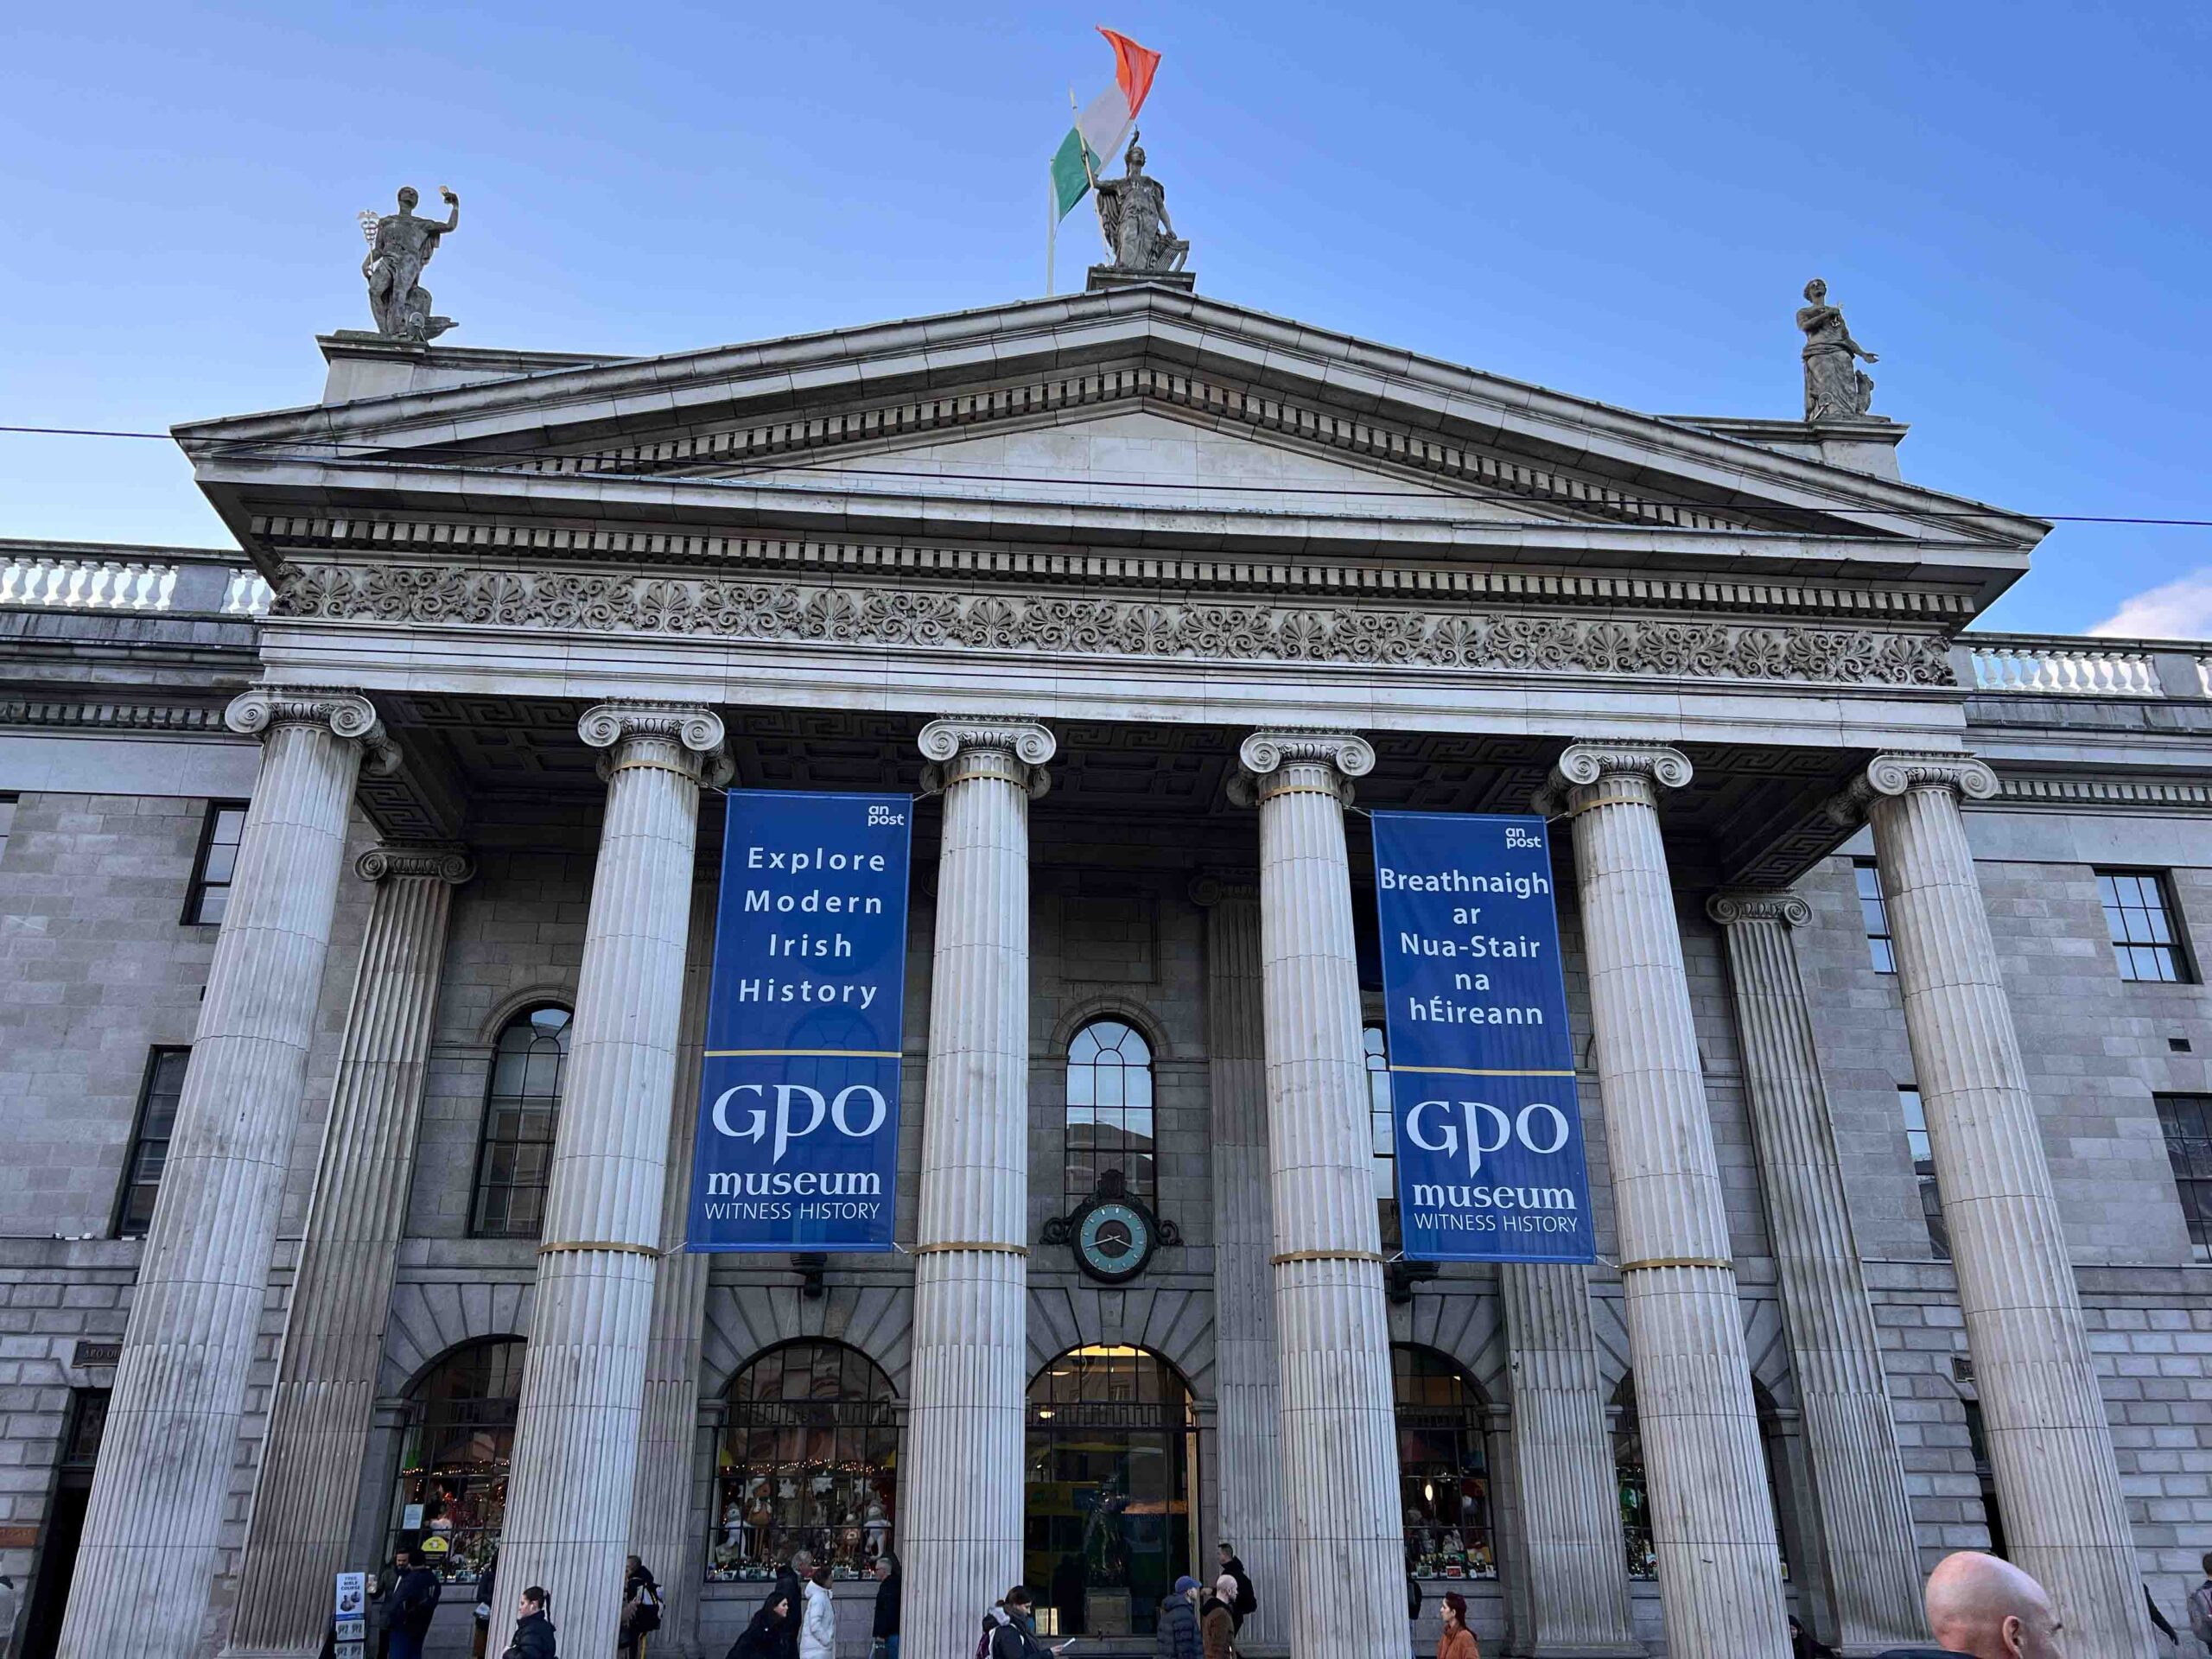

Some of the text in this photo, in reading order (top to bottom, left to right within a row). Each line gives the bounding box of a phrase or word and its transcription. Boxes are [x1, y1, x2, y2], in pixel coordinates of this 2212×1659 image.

[868, 813, 904, 826] post
[869, 806, 888, 815] an
[1506, 828, 1525, 837] an
[1507, 836, 1541, 849] post
[749, 848, 884, 874] Explore
[1381, 868, 1548, 899] Breathnaigh
[745, 890, 880, 913] Modern
[1453, 908, 1480, 924] ar
[770, 934, 850, 957] Irish
[1402, 933, 1540, 957] Nua-Stair
[1456, 974, 1489, 990] na
[740, 979, 876, 1009] History
[1410, 996, 1542, 1024] hÉireann
[707, 1173, 880, 1198] museum
[1413, 1185, 1576, 1210] museum
[705, 1203, 880, 1219] WITNESS HISTORY
[1414, 1214, 1577, 1232] WITNESS HISTORY
